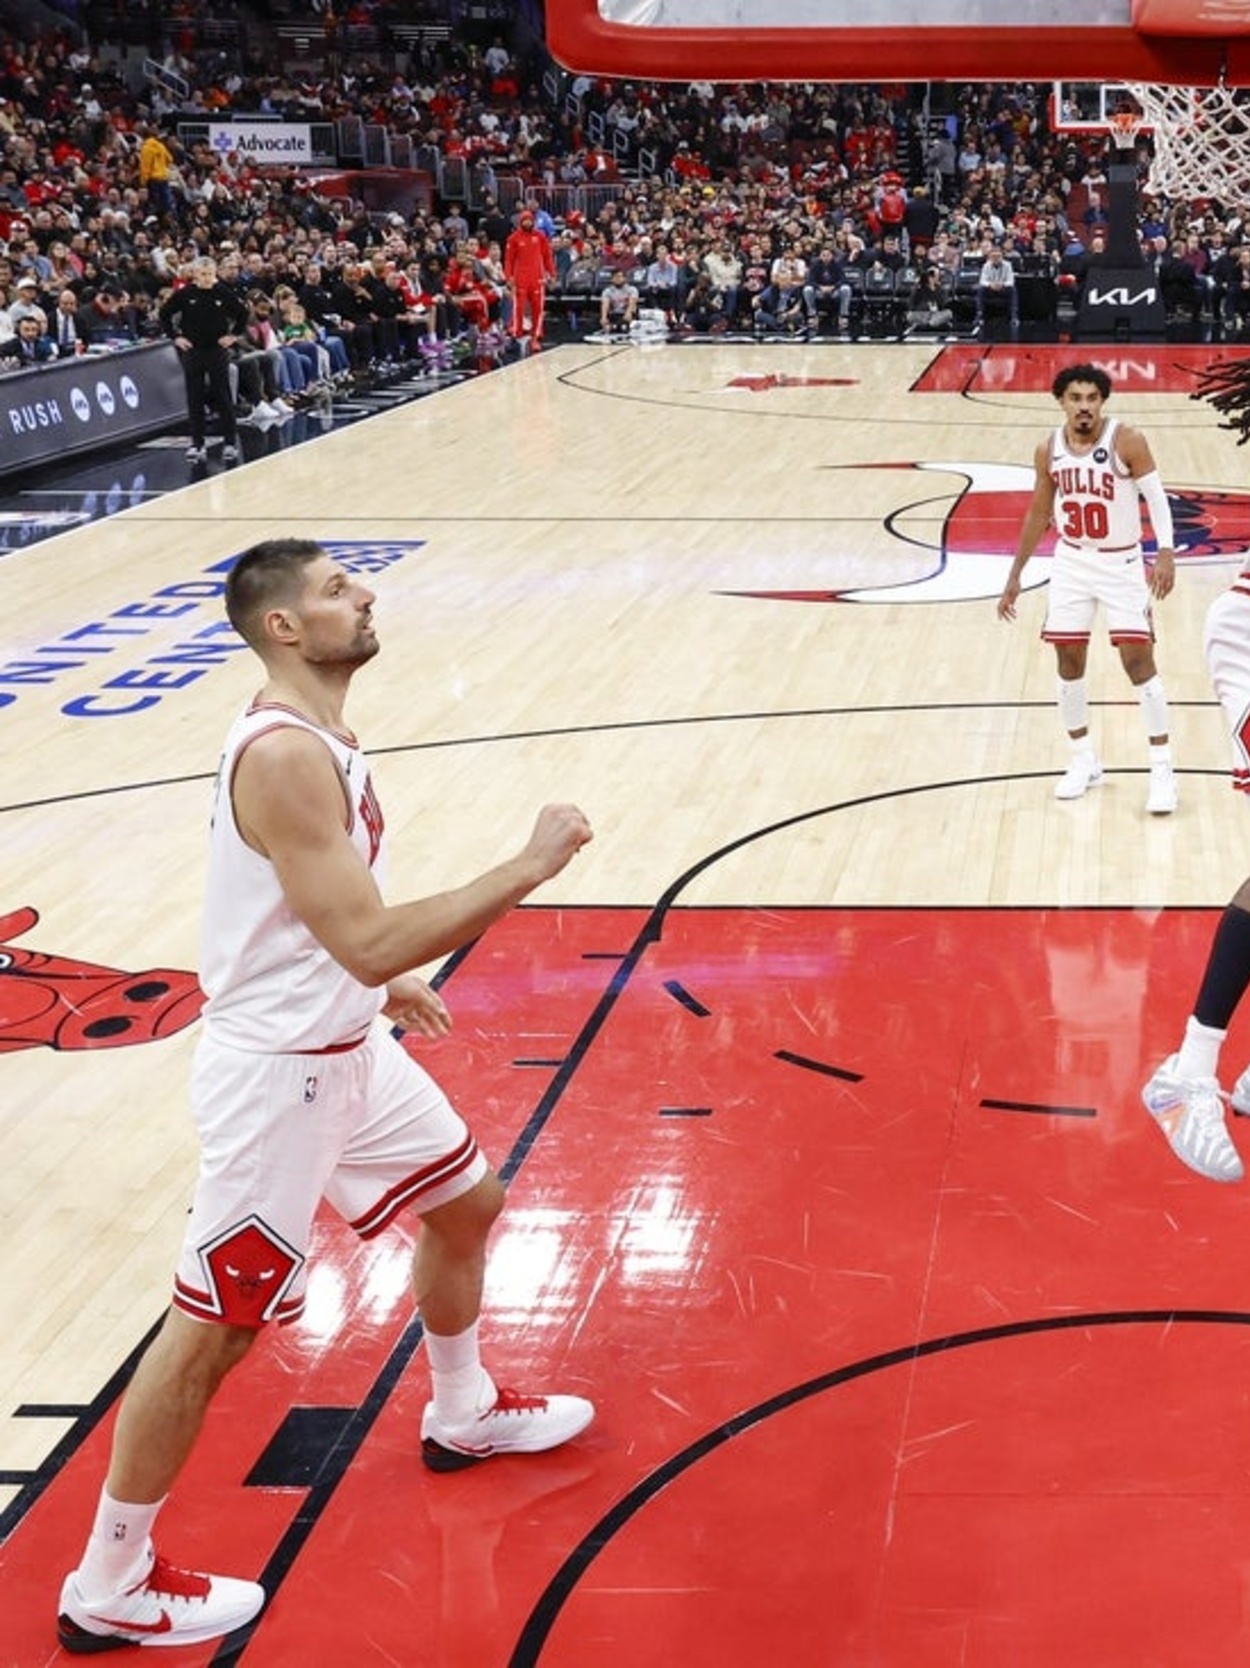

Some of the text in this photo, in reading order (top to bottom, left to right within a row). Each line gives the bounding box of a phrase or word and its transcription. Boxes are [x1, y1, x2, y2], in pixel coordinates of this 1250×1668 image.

[236, 133, 306, 151] Advocate
[8, 399, 62, 435] RUSH
[1061, 501, 1109, 539] 30
